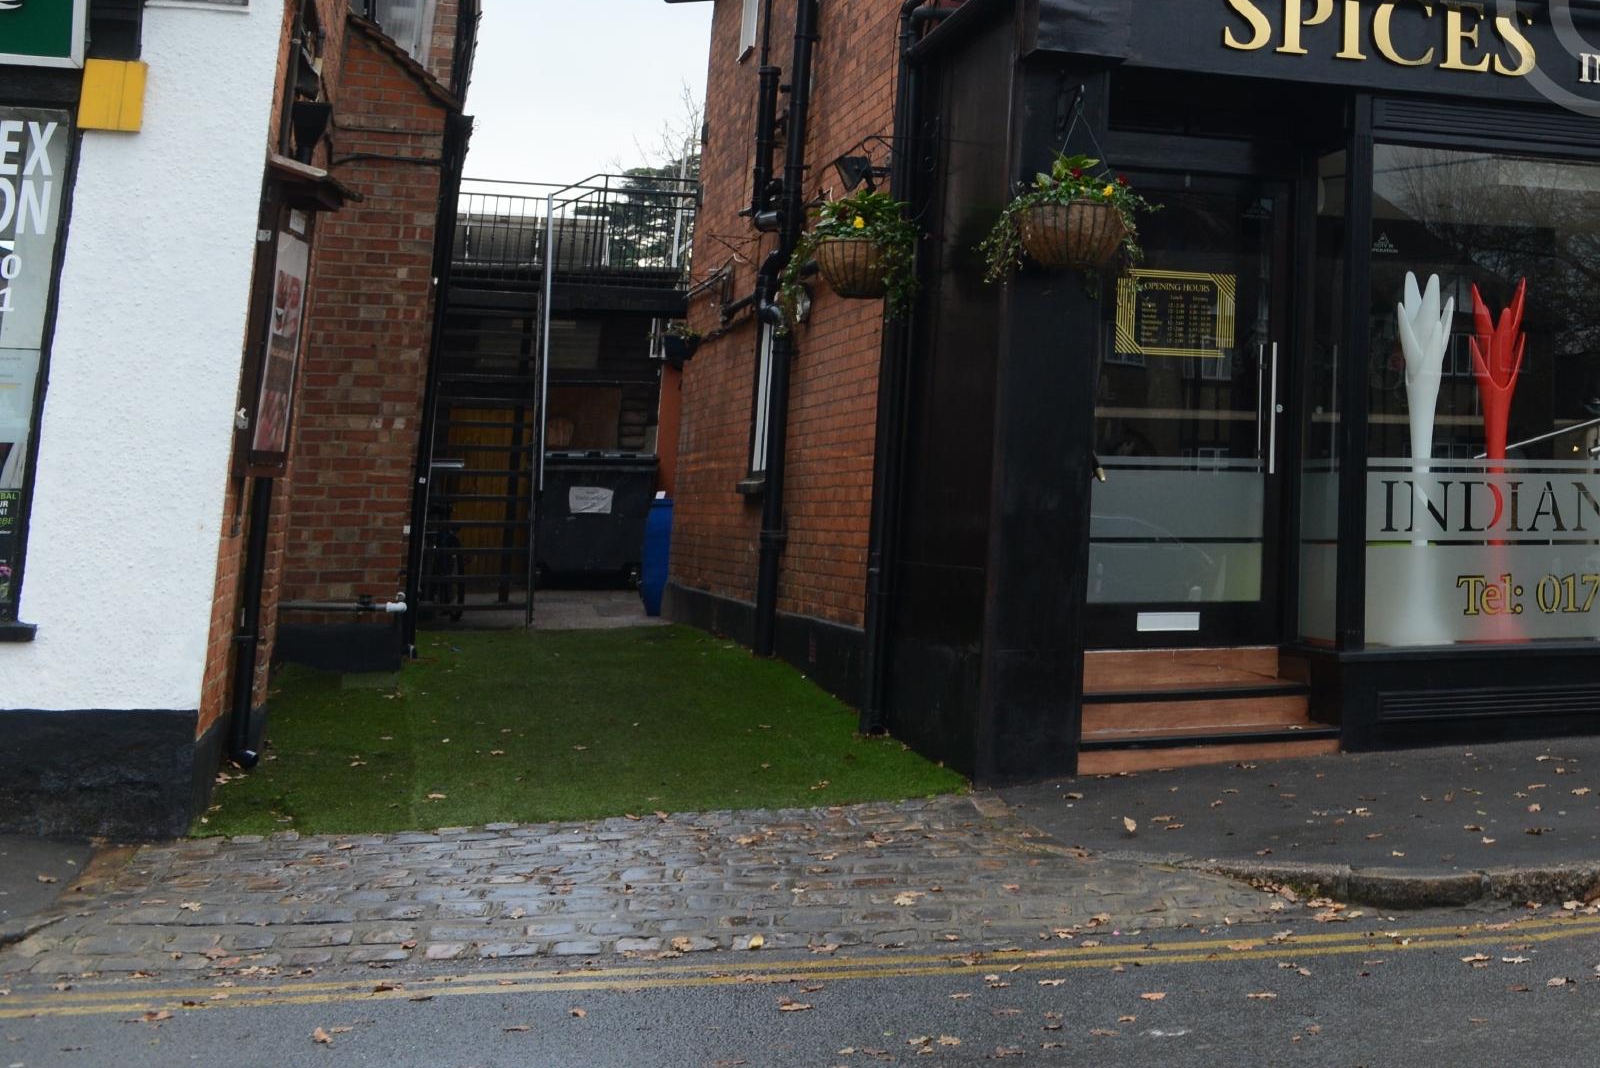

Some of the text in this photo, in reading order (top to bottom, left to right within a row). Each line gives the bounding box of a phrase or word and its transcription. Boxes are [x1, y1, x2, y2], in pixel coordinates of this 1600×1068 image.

[1144, 282, 1210, 293] OPENING HOURS
[1456, 573, 1524, 616] Tel:
